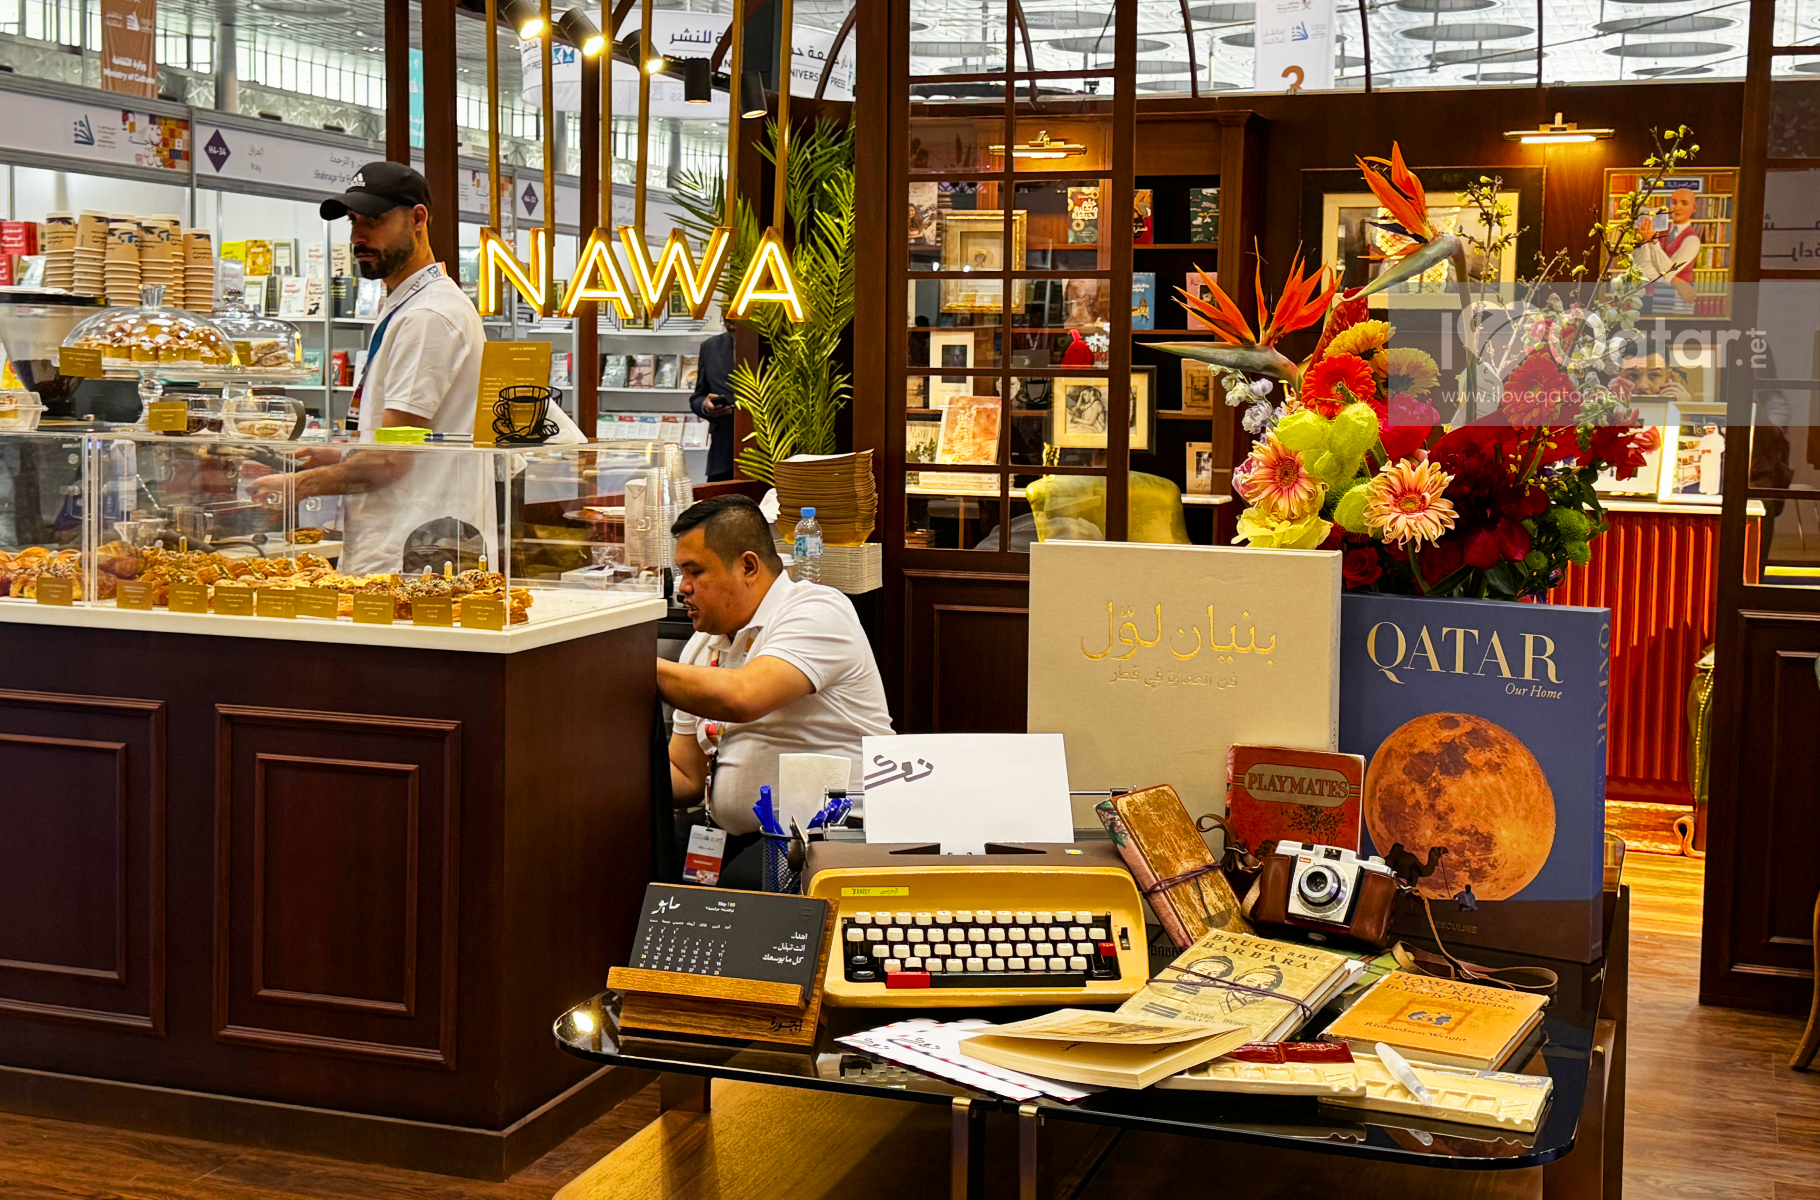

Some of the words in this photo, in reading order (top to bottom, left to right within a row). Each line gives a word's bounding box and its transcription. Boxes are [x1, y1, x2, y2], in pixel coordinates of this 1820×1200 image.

[670, 28, 712, 44] للنشر
[479, 226, 812, 323] NAWA
[1170, 603, 1277, 667] بنيان
[1366, 622, 1564, 684] QATAR
[1108, 665, 1140, 684] قطر
[1167, 670, 1213, 687] العمارة
[1505, 682, 1528, 697] Our
[1530, 684, 1563, 700] Home
[1247, 772, 1348, 798] PLAYMATES
[1435, 921, 1478, 934] SSOULINE
[1202, 941, 1310, 970] BARBARA
[1212, 934, 1282, 954] BRUCE
[1287, 951, 1320, 961] and
